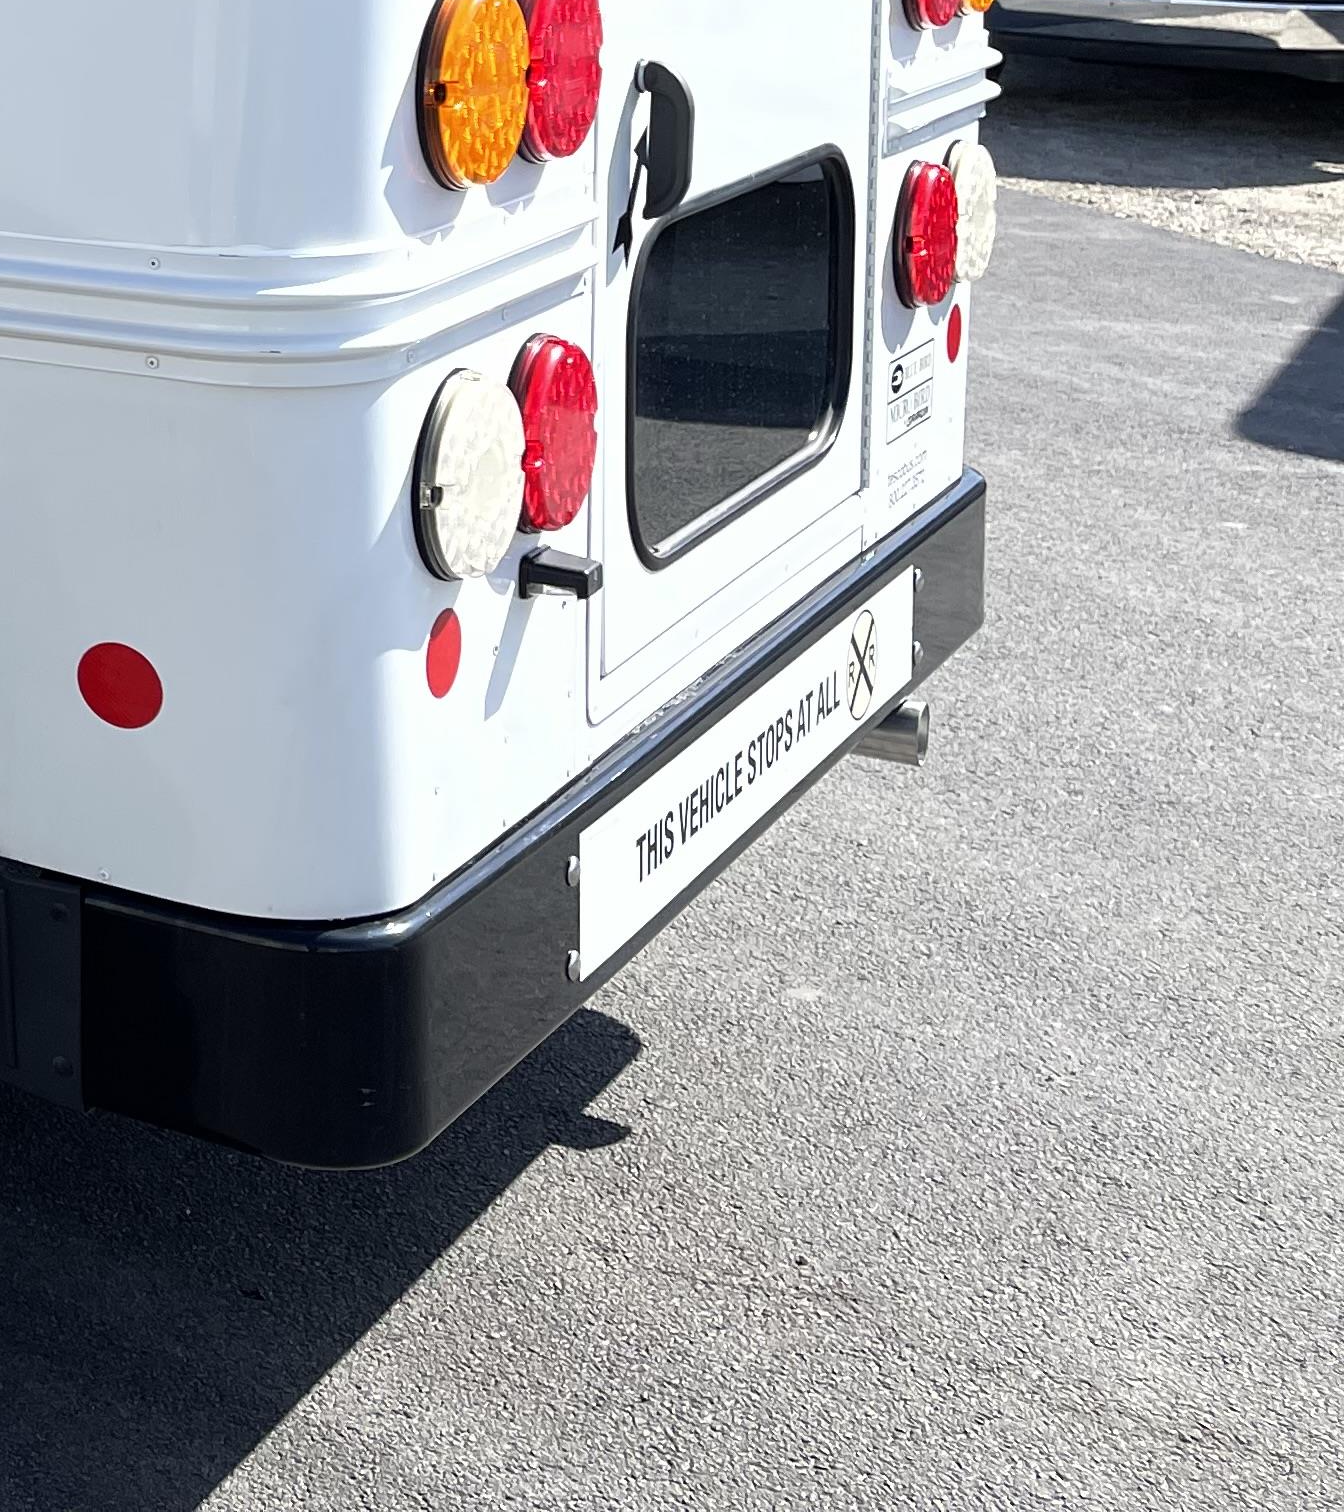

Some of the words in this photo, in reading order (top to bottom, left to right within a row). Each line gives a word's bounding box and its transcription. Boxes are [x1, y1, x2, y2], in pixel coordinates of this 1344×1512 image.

[636, 811, 674, 883] THIS
[679, 750, 743, 845] VEHICLE
[747, 708, 793, 785] STOPS
[796, 690, 814, 743] AT
[816, 670, 840, 726] ALL
